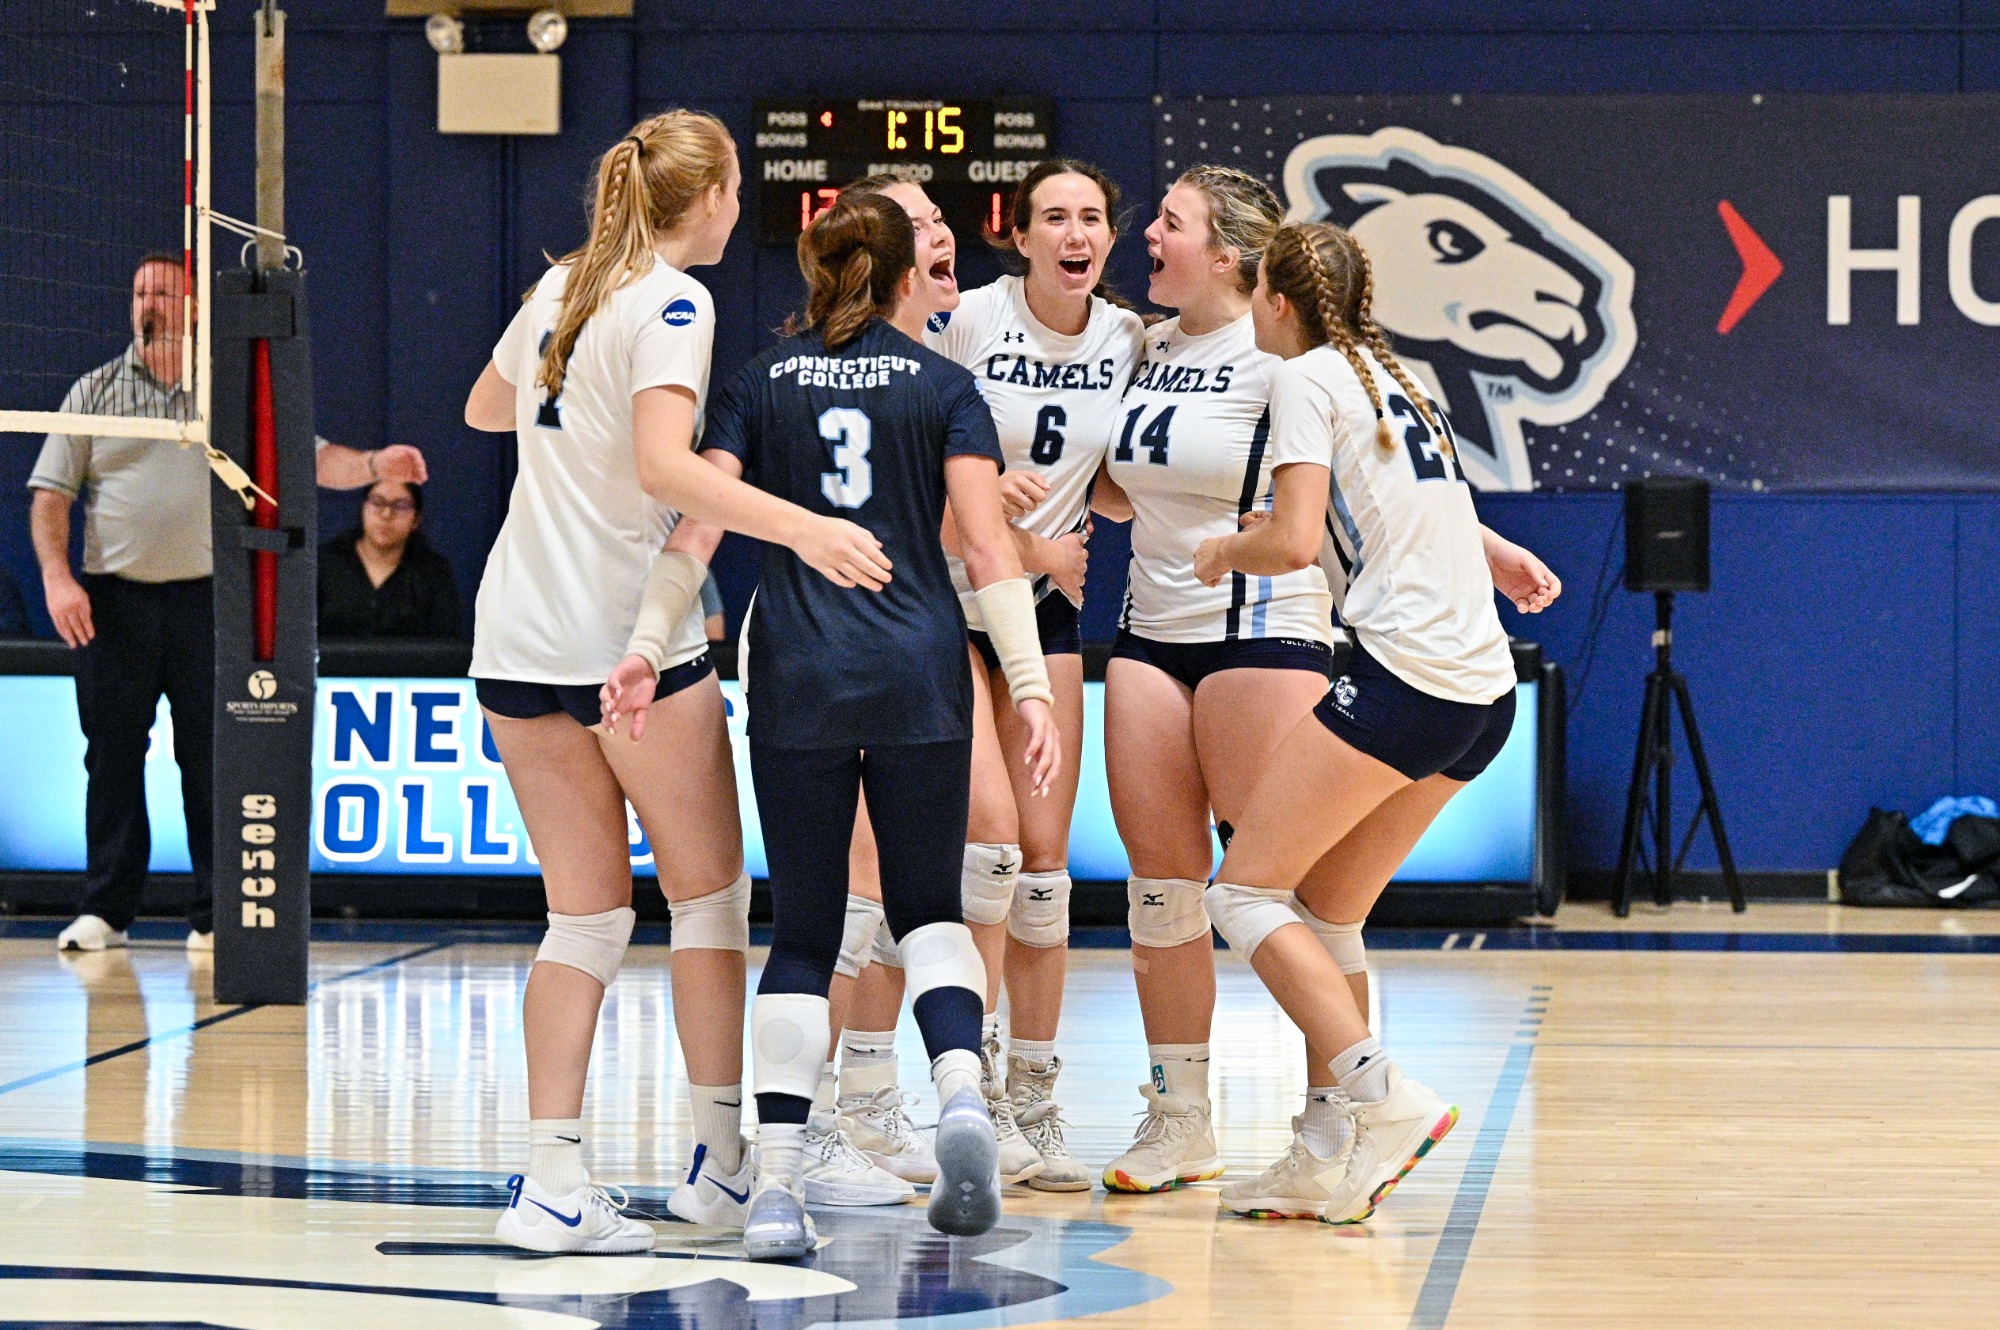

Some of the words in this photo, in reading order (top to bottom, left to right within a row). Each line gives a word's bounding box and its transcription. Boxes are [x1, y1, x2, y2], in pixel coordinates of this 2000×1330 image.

[764, 160, 828, 181] HOME
[769, 355, 921, 379] CONNECTICUT
[798, 369, 890, 389] COLLEGE
[987, 353, 1115, 390] CAMELS
[1029, 403, 1068, 466] 6
[1114, 403, 1179, 467] 14
[818, 406, 873, 509] 3
